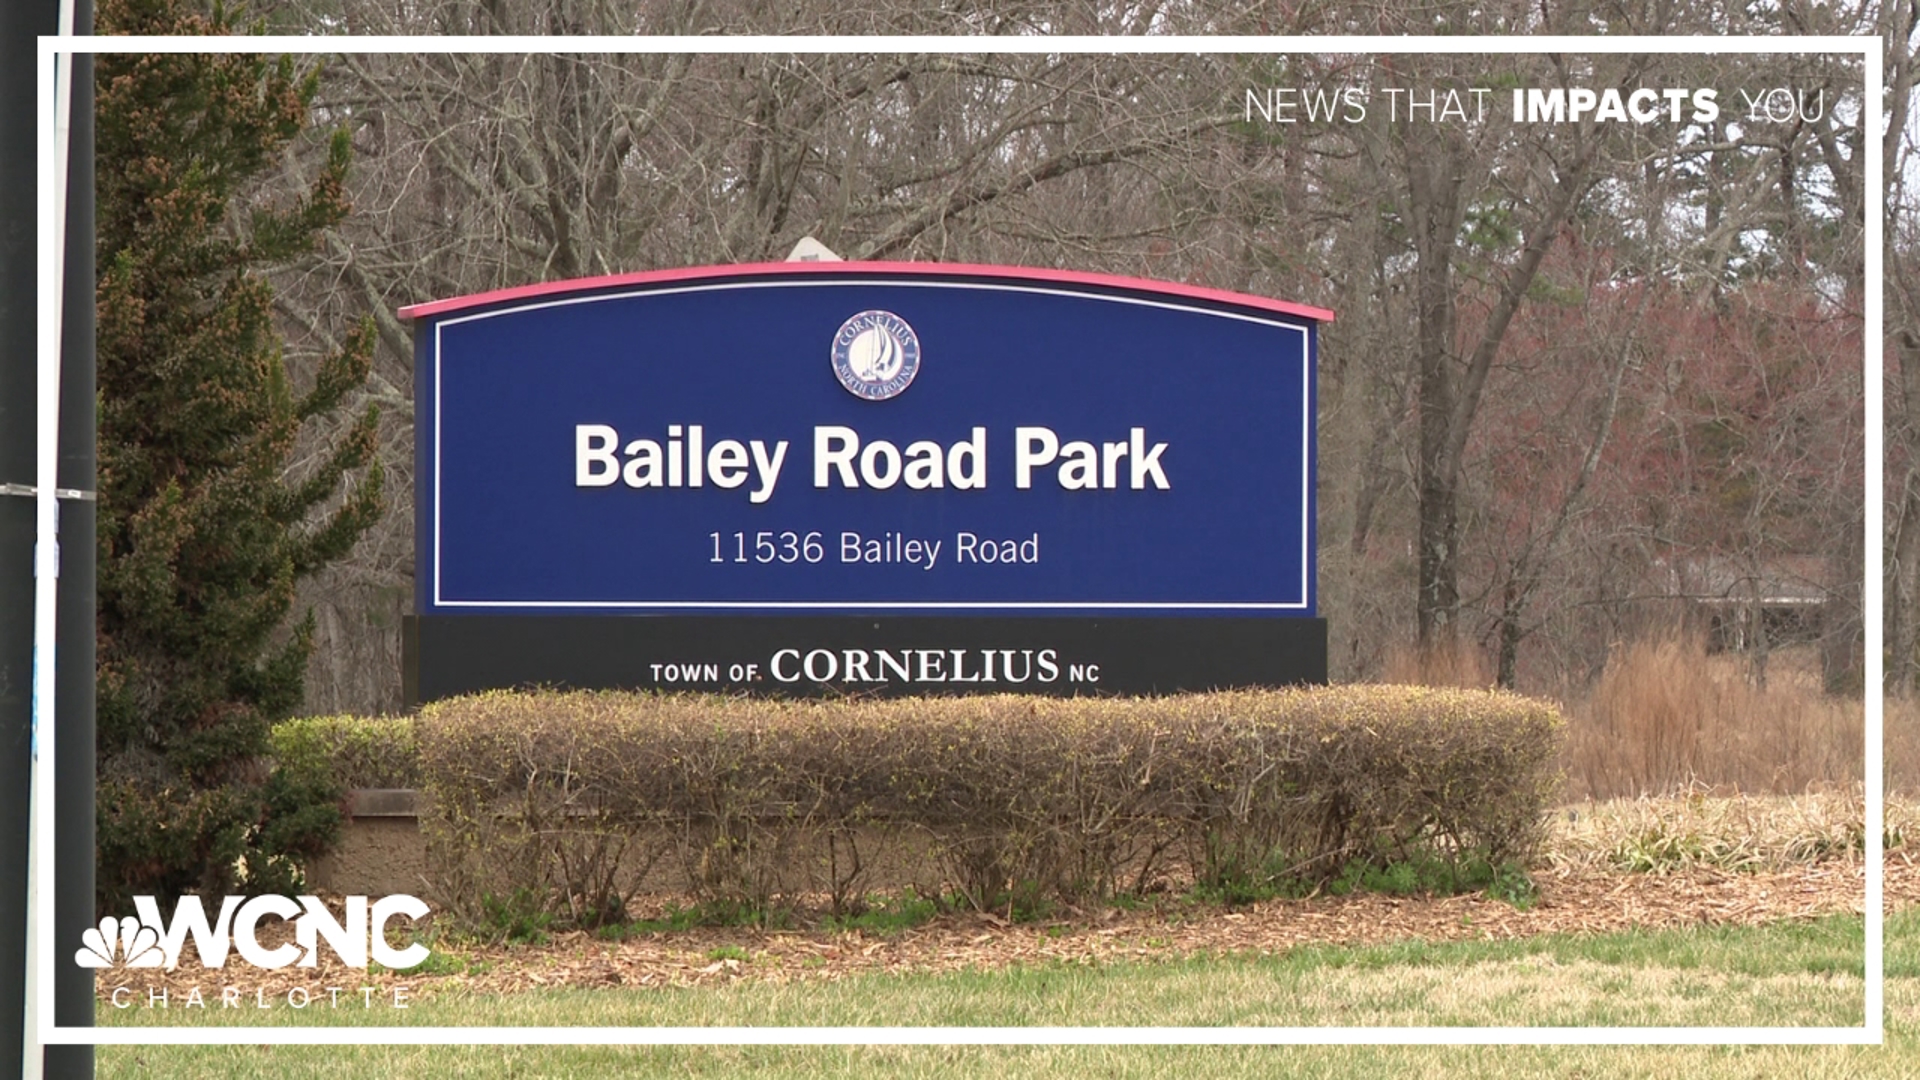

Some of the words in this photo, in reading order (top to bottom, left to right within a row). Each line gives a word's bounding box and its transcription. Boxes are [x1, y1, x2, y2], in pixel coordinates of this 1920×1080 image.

[840, 315, 912, 346] CORNELIUS
[840, 364, 868, 394] NORTH
[870, 365, 913, 396] CAROLINA
[575, 424, 789, 504] Bailey
[814, 425, 988, 491] Road
[1016, 426, 1172, 491] Park
[709, 531, 825, 565] 11536
[840, 531, 943, 571] Bailey
[956, 531, 1040, 565] Road
[650, 663, 719, 683] TOWN
[729, 663, 759, 683] OF
[770, 648, 1060, 683] CORNELIUS
[1070, 664, 1101, 683] NC
